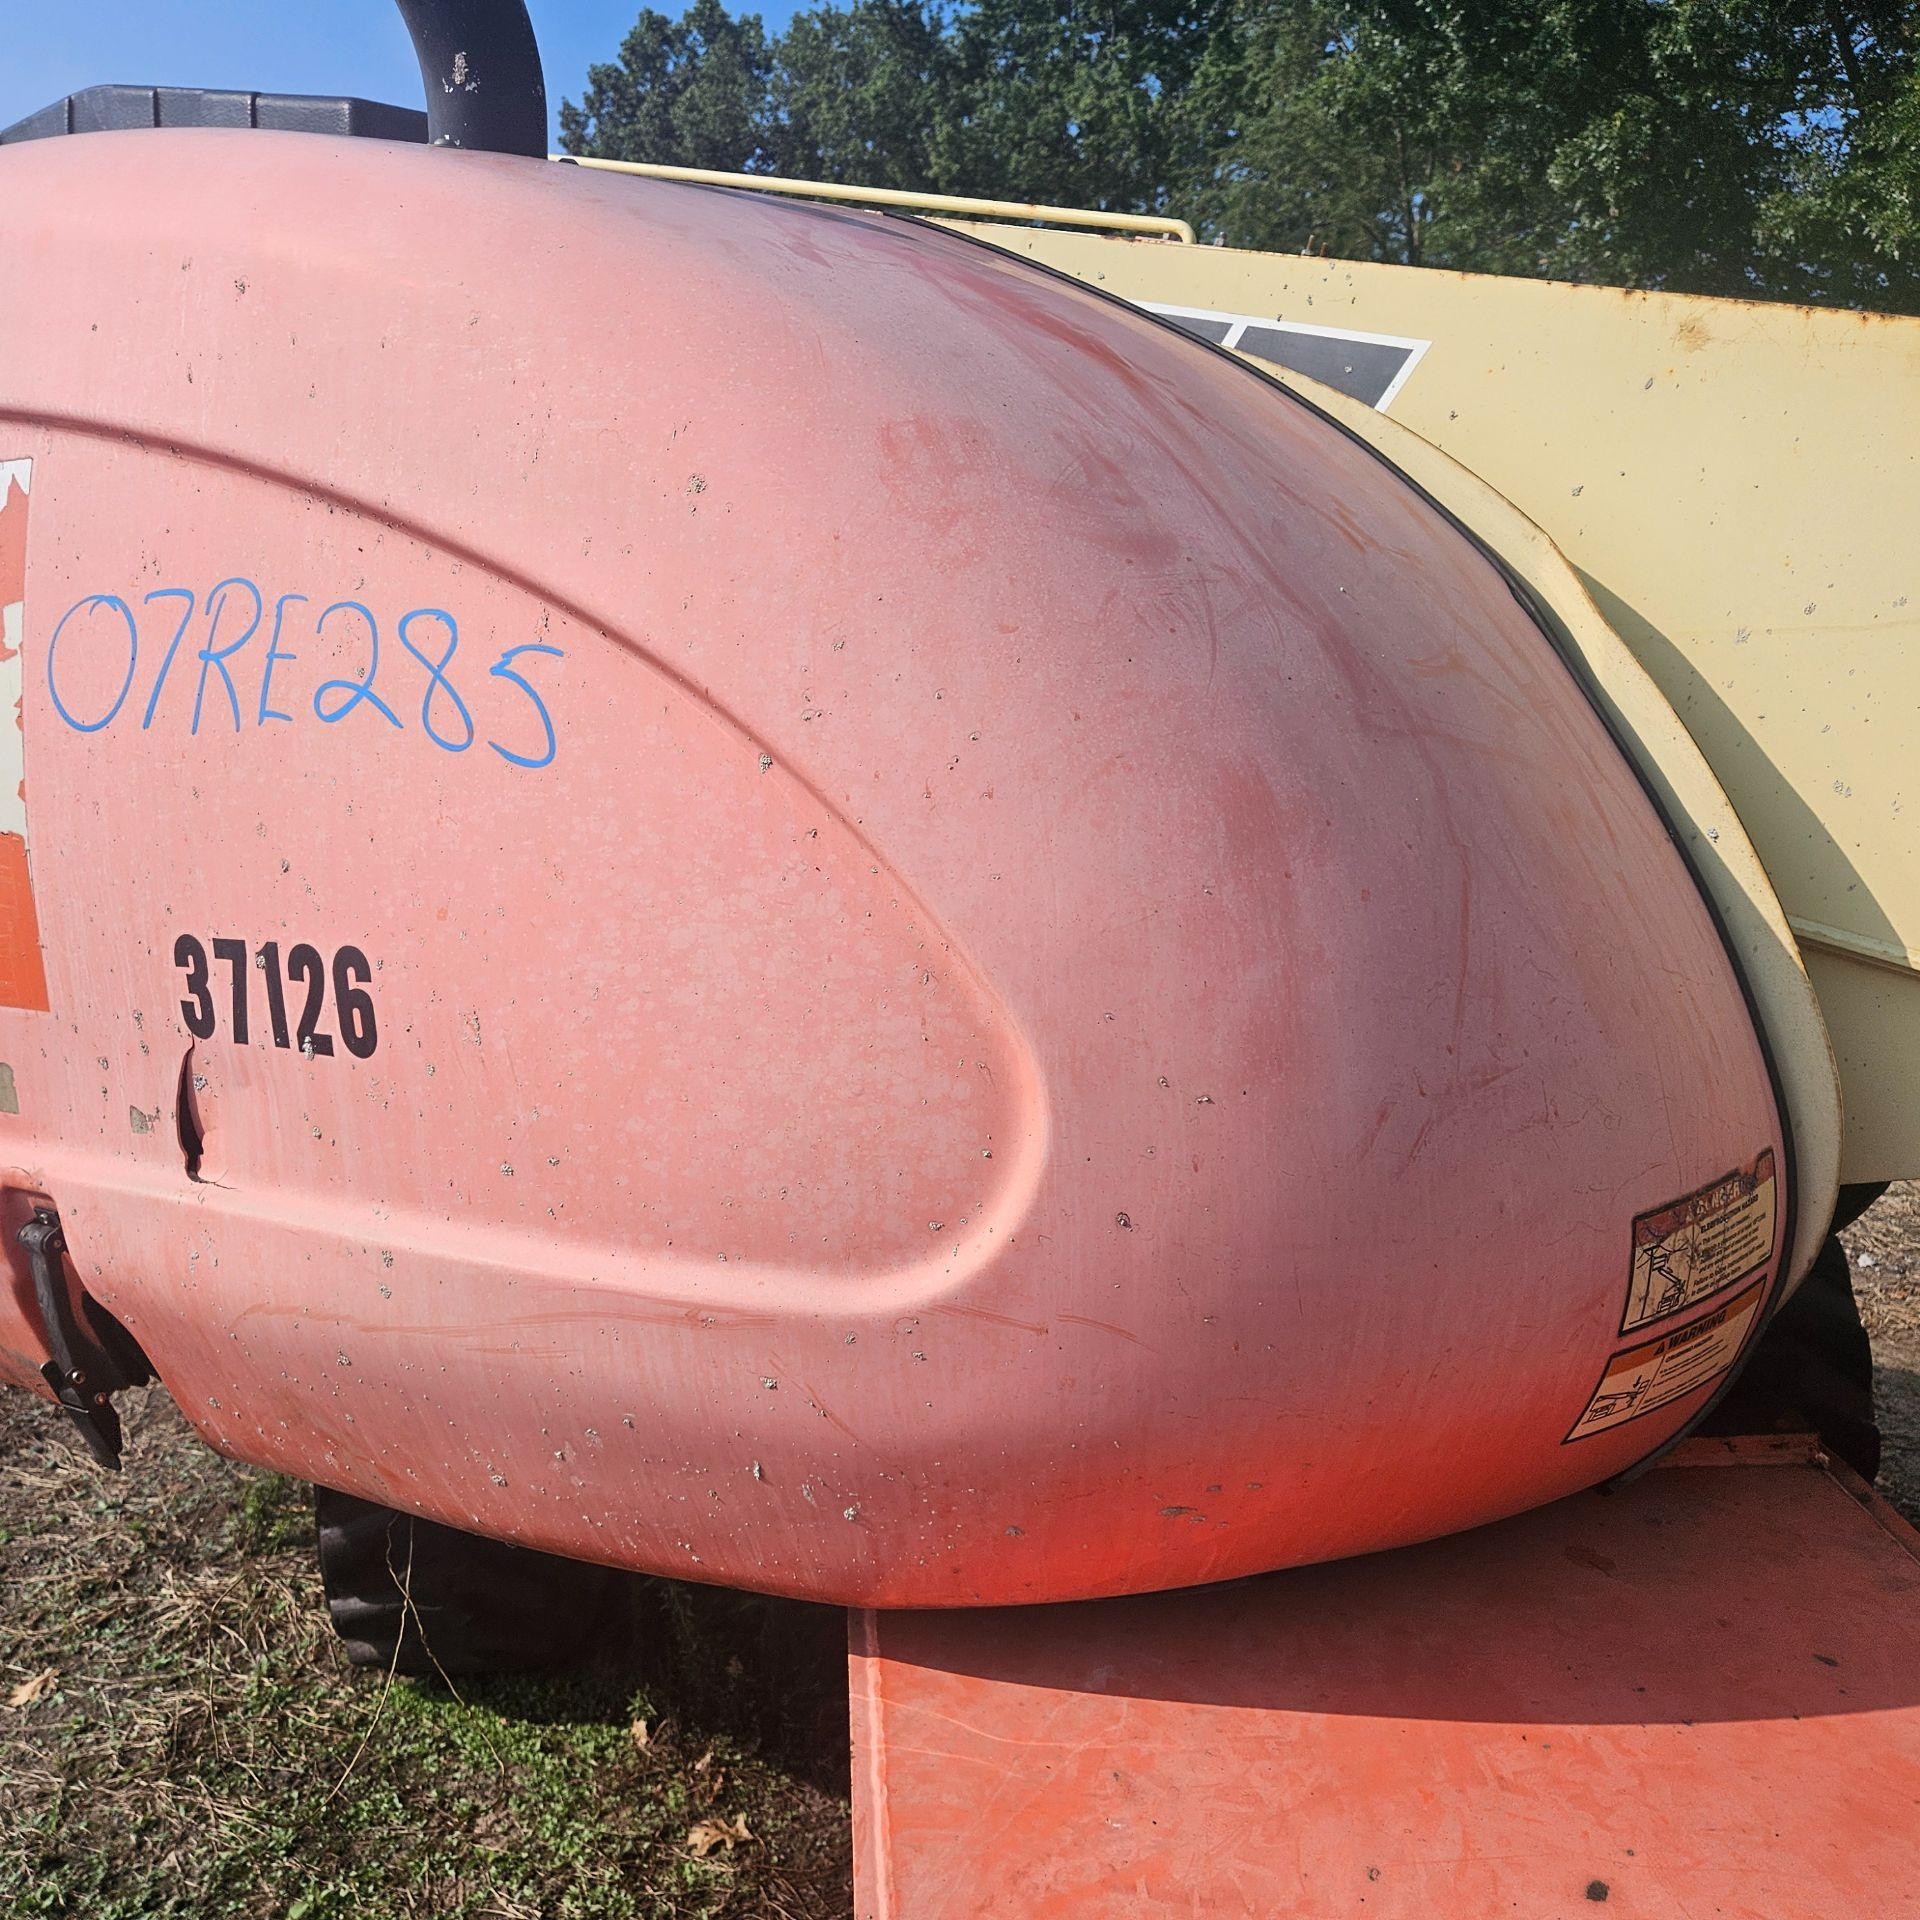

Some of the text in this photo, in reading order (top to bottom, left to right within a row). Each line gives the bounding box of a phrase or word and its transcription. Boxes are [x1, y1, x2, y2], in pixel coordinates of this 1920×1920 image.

[49, 578, 562, 768] 07RE285
[173, 933, 378, 1059] 37126
[1668, 1308, 1727, 1349] WARNING
